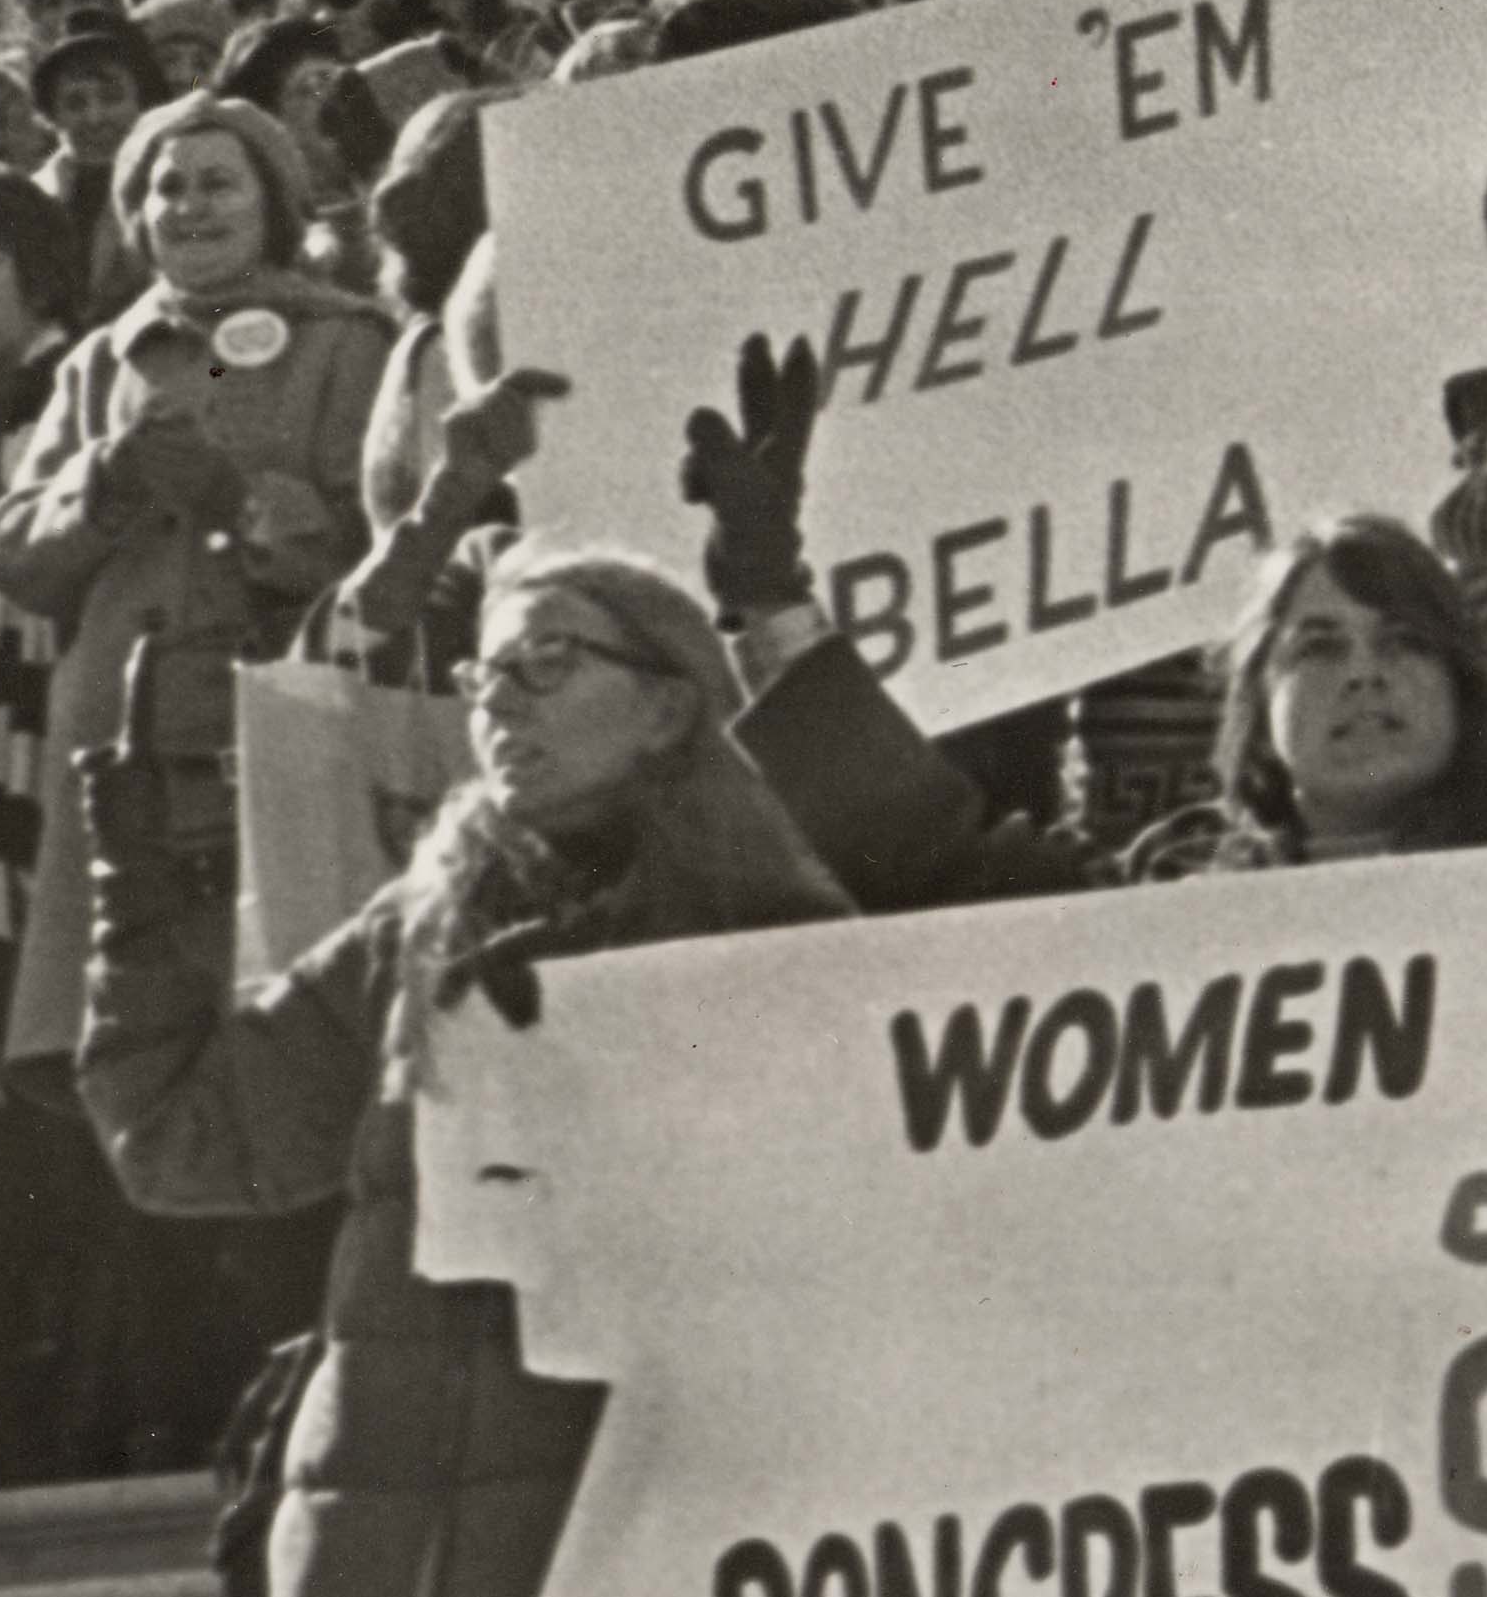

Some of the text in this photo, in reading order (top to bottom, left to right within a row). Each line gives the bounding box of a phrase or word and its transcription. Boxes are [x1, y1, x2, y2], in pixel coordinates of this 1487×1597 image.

[683, 66, 983, 244] GIVE
[821, 212, 1165, 404] HELL
[829, 441, 1275, 682] BELLA
[890, 952, 1435, 1152] WOMEN
